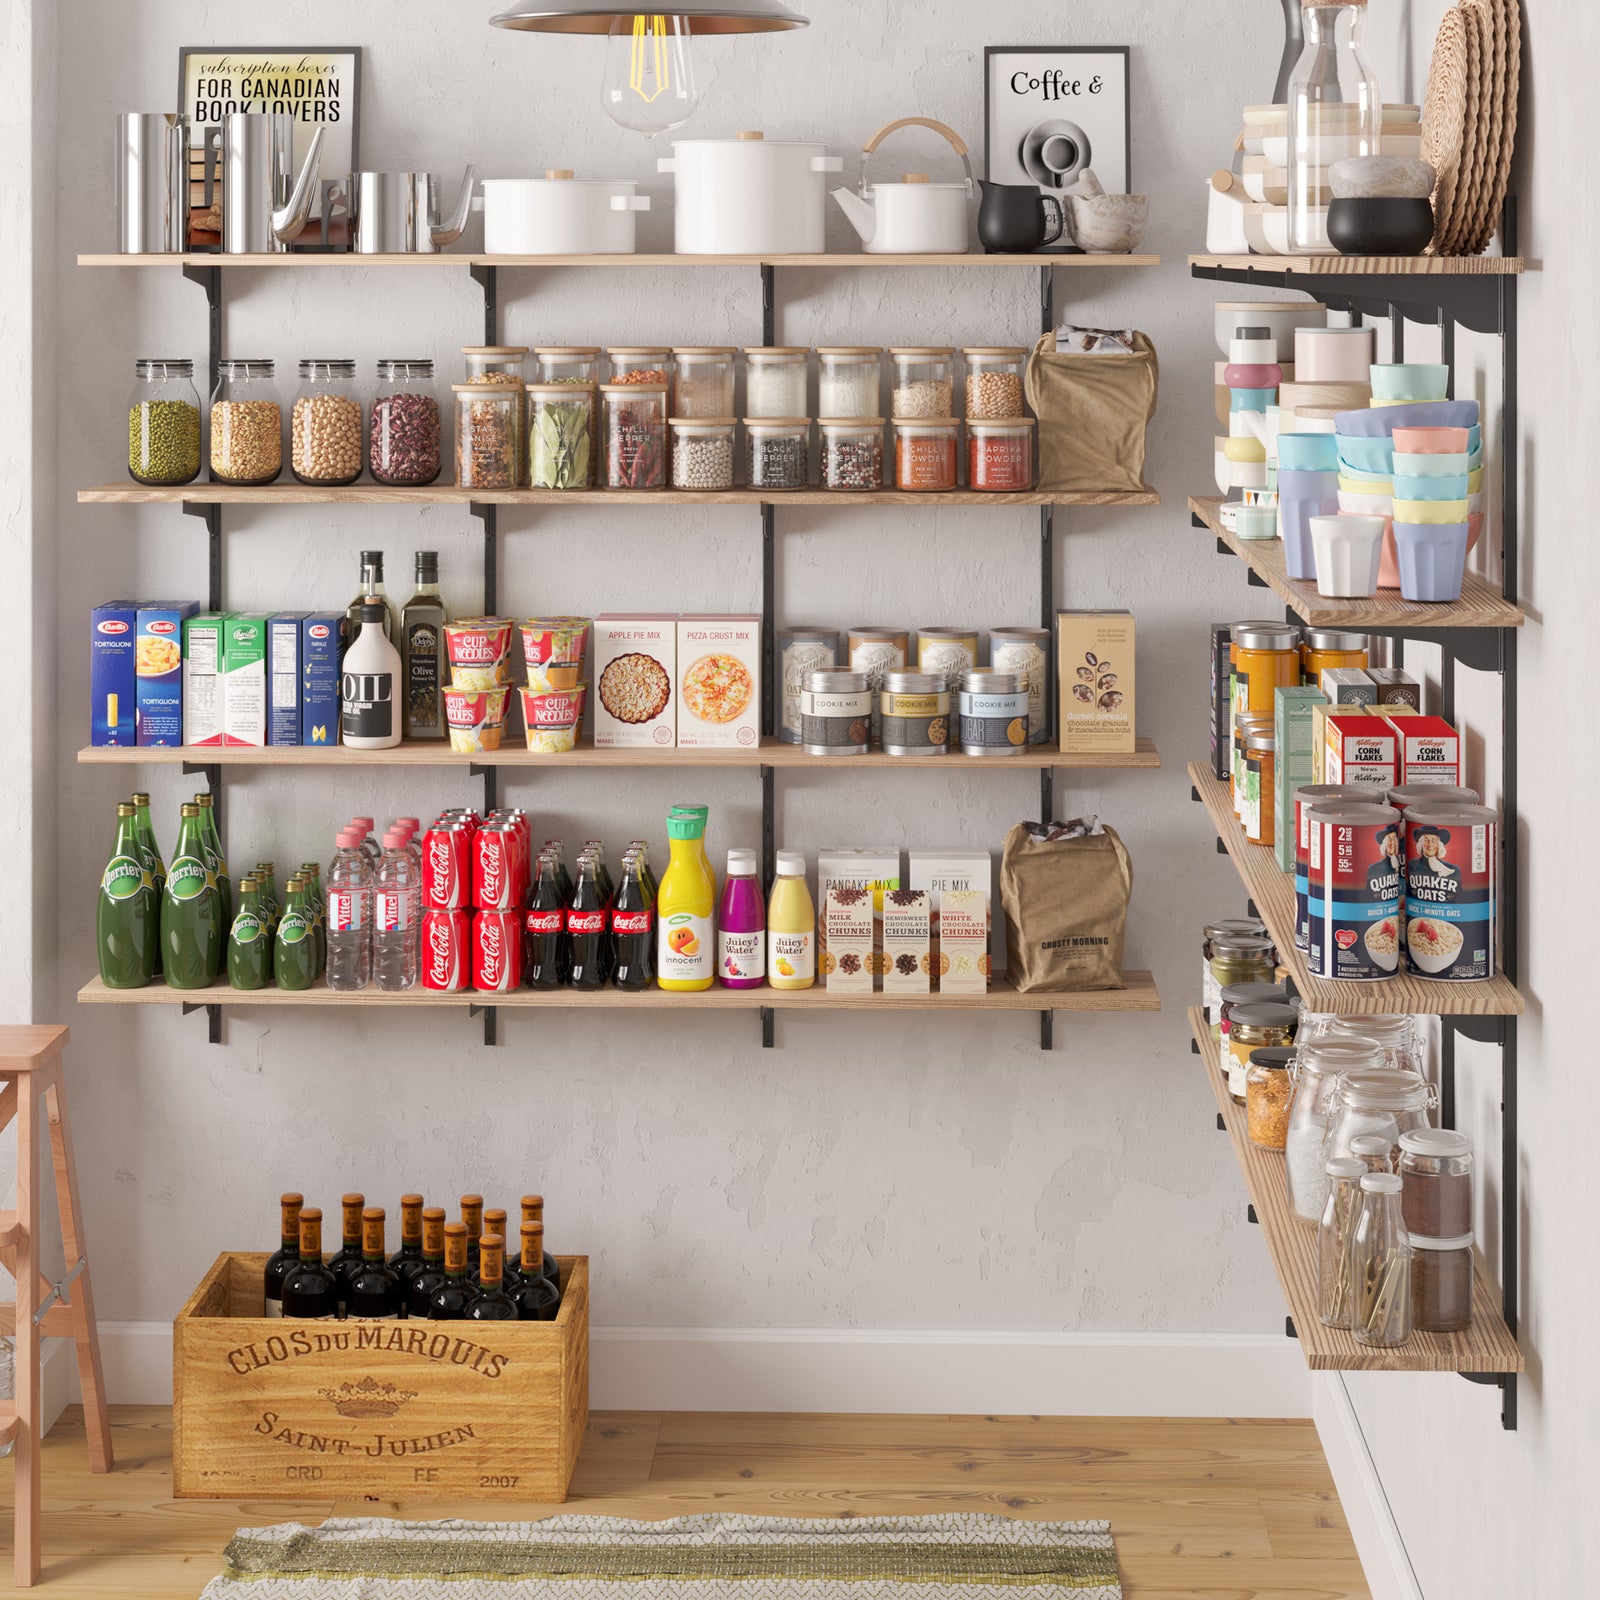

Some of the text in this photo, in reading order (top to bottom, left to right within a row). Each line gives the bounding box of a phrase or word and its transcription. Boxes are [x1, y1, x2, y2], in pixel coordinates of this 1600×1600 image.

[199, 57, 337, 79] subscription boxes
[197, 79, 340, 98] FOR CANADIAN
[1010, 70, 1103, 100] Coffee &
[196, 101, 252, 122] BOOK
[760, 445, 792, 453] BLACK
[911, 454, 947, 463] OWDER
[608, 631, 661, 639] APPLE PIE MIX
[687, 632, 750, 640] PIZZA CRUST MIX
[463, 635, 487, 648] CUP
[455, 646, 494, 659] NOODLES
[412, 666, 435, 676] Olive
[343, 673, 392, 702] OIL
[545, 698, 569, 710] CUP
[815, 700, 844, 708] COOKIE
[535, 709, 574, 722] NOODLES
[1101, 720, 1129, 728] granola
[1355, 739, 1384, 747] Kellogg's
[1417, 739, 1446, 747] Kellogg's
[1358, 747, 1380, 755] CORN
[1419, 747, 1443, 755] CORN
[1354, 774, 1387, 782] Kellogg's
[1338, 827, 1345, 841] 2
[1338, 844, 1344, 856] 5
[1338, 859, 1352, 869] 55+
[826, 879, 892, 890] PANCAKE MIX
[931, 880, 970, 891] PIE MIX
[1409, 874, 1458, 892] QUAKER
[1381, 886, 1399, 901] OATS
[1417, 890, 1447, 902] OATS
[339, 895, 351, 926] Vittel
[386, 895, 398, 926] Vittel
[1420, 907, 1445, 917] 1-MINUTE
[1446, 909, 1461, 918] OATS
[725, 937, 753, 948] Juicy
[775, 938, 803, 948] Juicy
[1072, 937, 1109, 946] MORNING
[725, 945, 755, 955] Water
[775, 946, 805, 955] Water
[665, 955, 702, 964] innocent
[227, 1325, 509, 1378] CLOS DU MARQUIS
[285, 1466, 323, 1481] CRD
[480, 1476, 520, 1488] 2007
